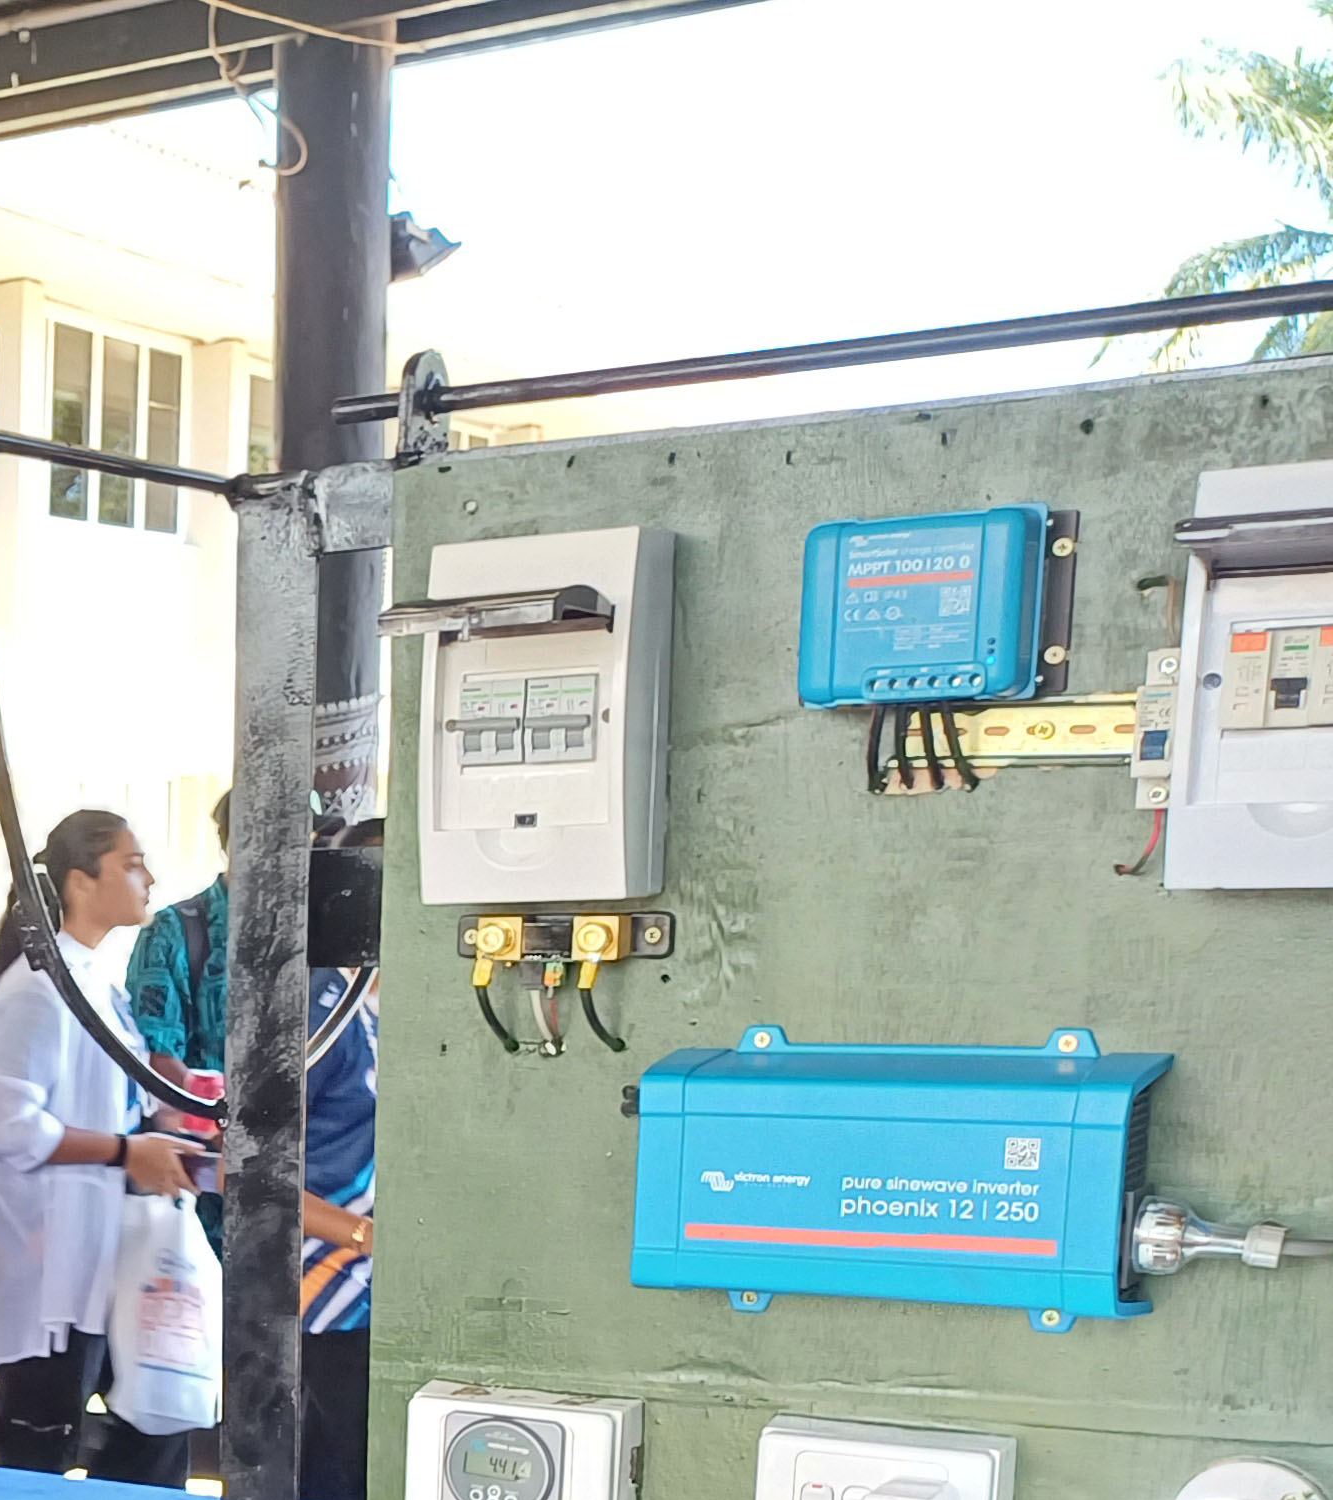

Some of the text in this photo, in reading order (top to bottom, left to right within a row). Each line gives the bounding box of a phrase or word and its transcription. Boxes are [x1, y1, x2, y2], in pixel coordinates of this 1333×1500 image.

[847, 560, 890, 577] MPPT
[841, 1175, 1040, 1197] pure sinewave inverter
[839, 1195, 940, 1219] phoenix
[948, 1198, 974, 1219] 12
[994, 1200, 1040, 1223] 250
